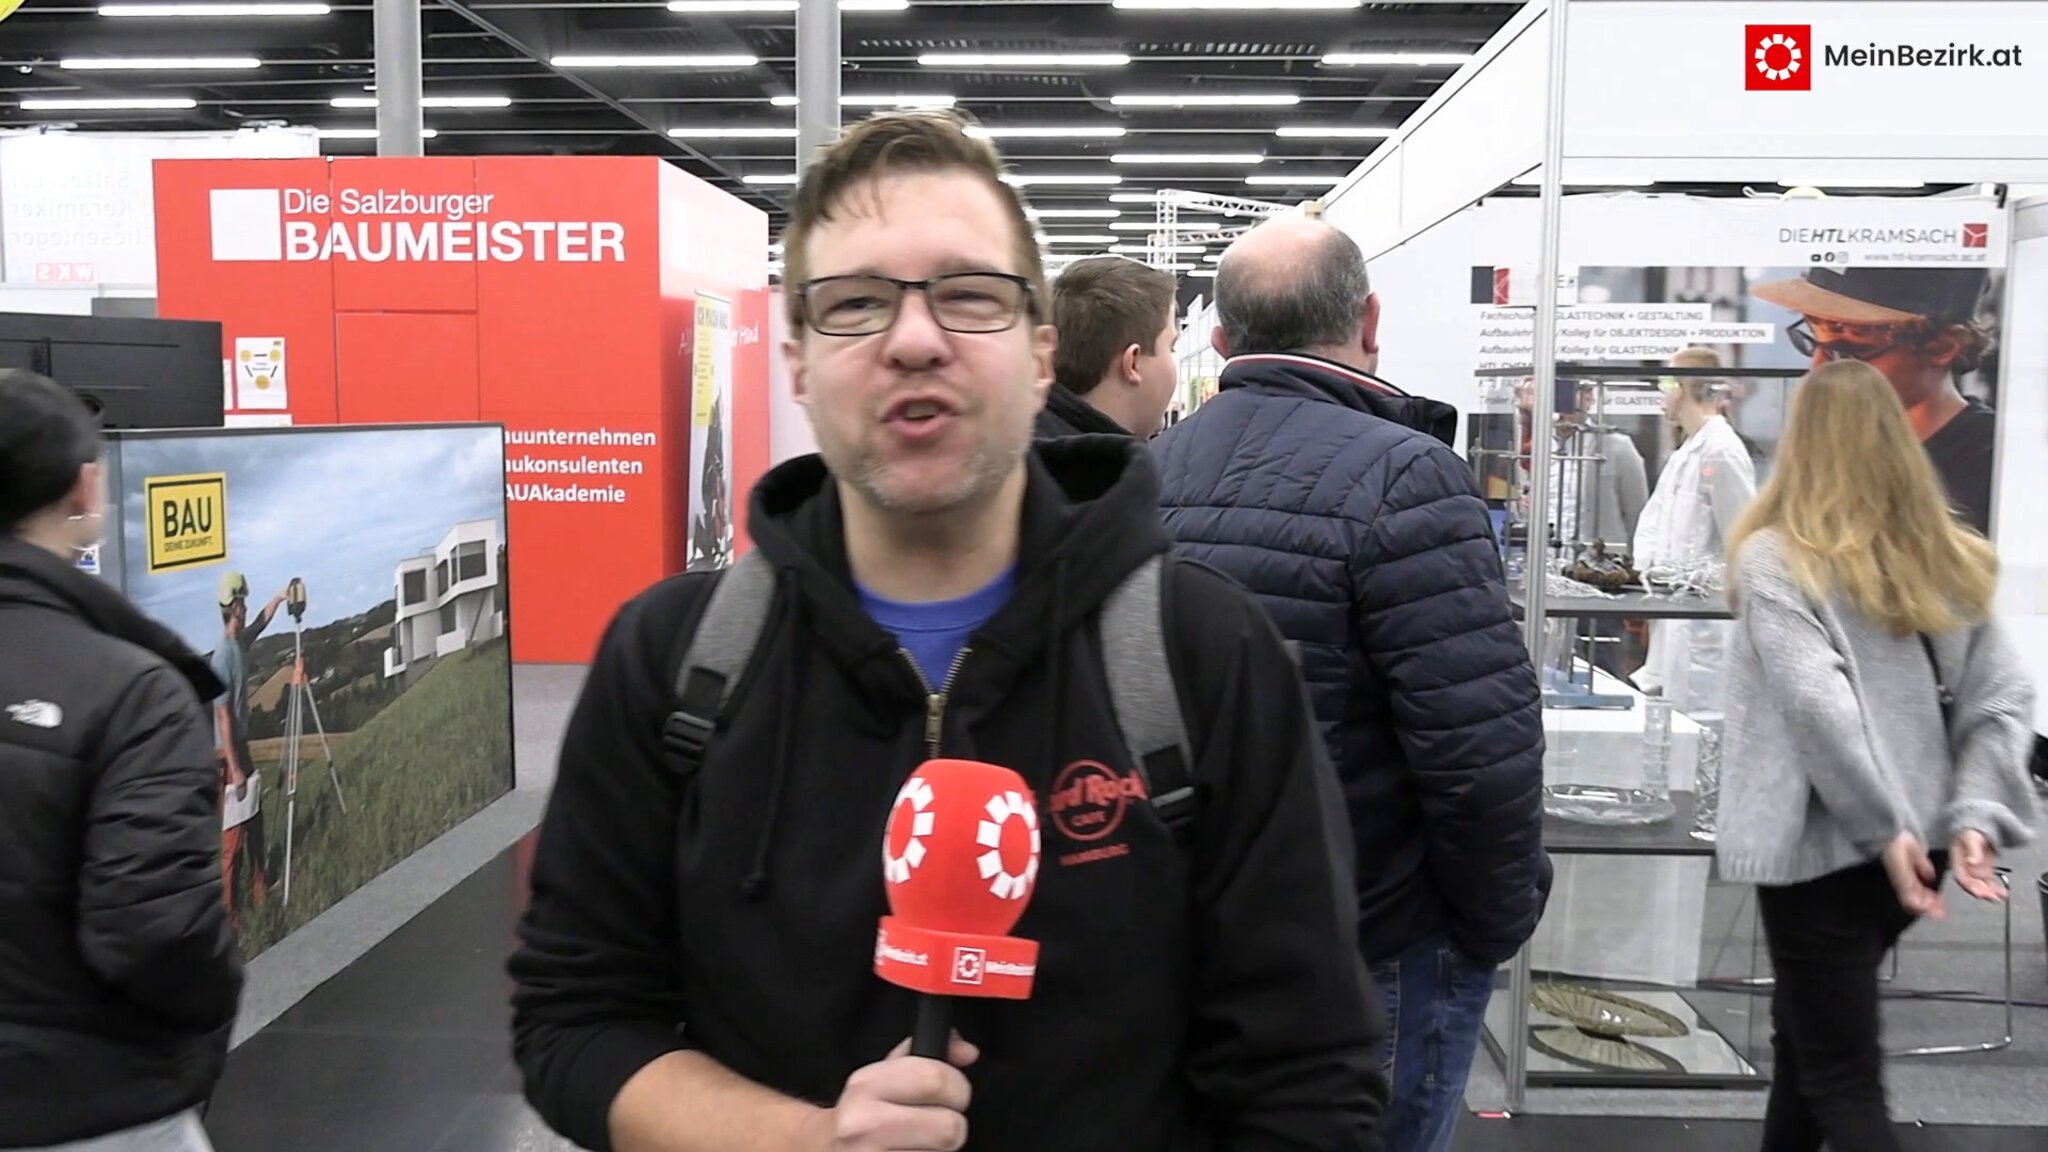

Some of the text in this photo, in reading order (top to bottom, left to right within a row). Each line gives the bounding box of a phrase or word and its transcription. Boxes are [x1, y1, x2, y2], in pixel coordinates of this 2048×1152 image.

[284, 188, 494, 220] Die Salzburger
[285, 220, 626, 262] BAUMEISTER
[163, 496, 212, 538] BAU
